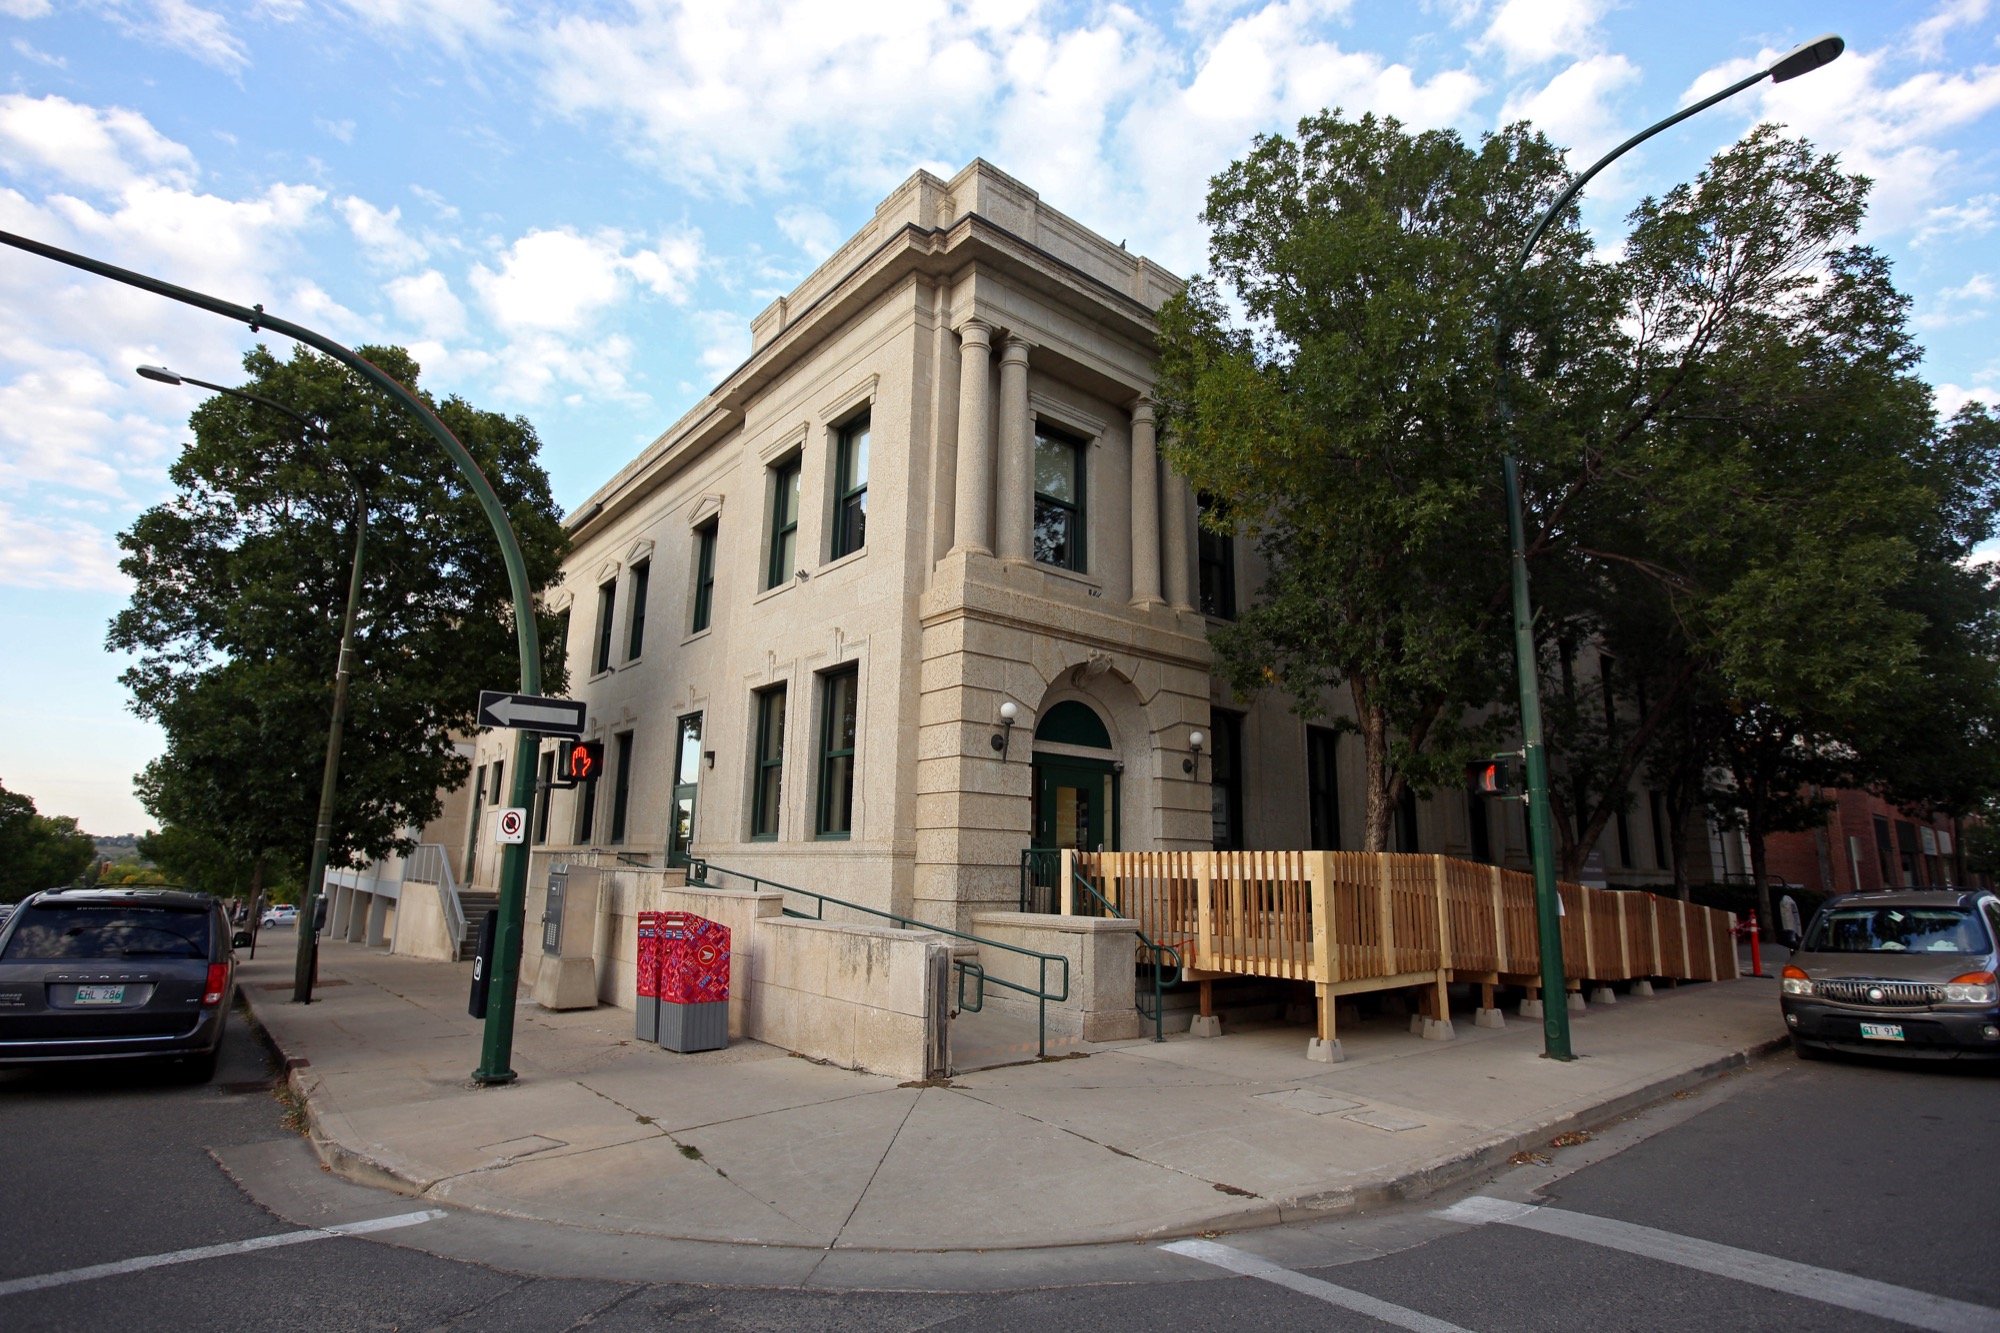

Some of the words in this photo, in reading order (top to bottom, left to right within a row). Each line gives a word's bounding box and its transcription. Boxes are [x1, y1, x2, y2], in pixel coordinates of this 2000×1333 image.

[690, 918, 704, 932] P9A
[78, 990, 97, 999] EHL
[103, 990, 121, 999] 286
